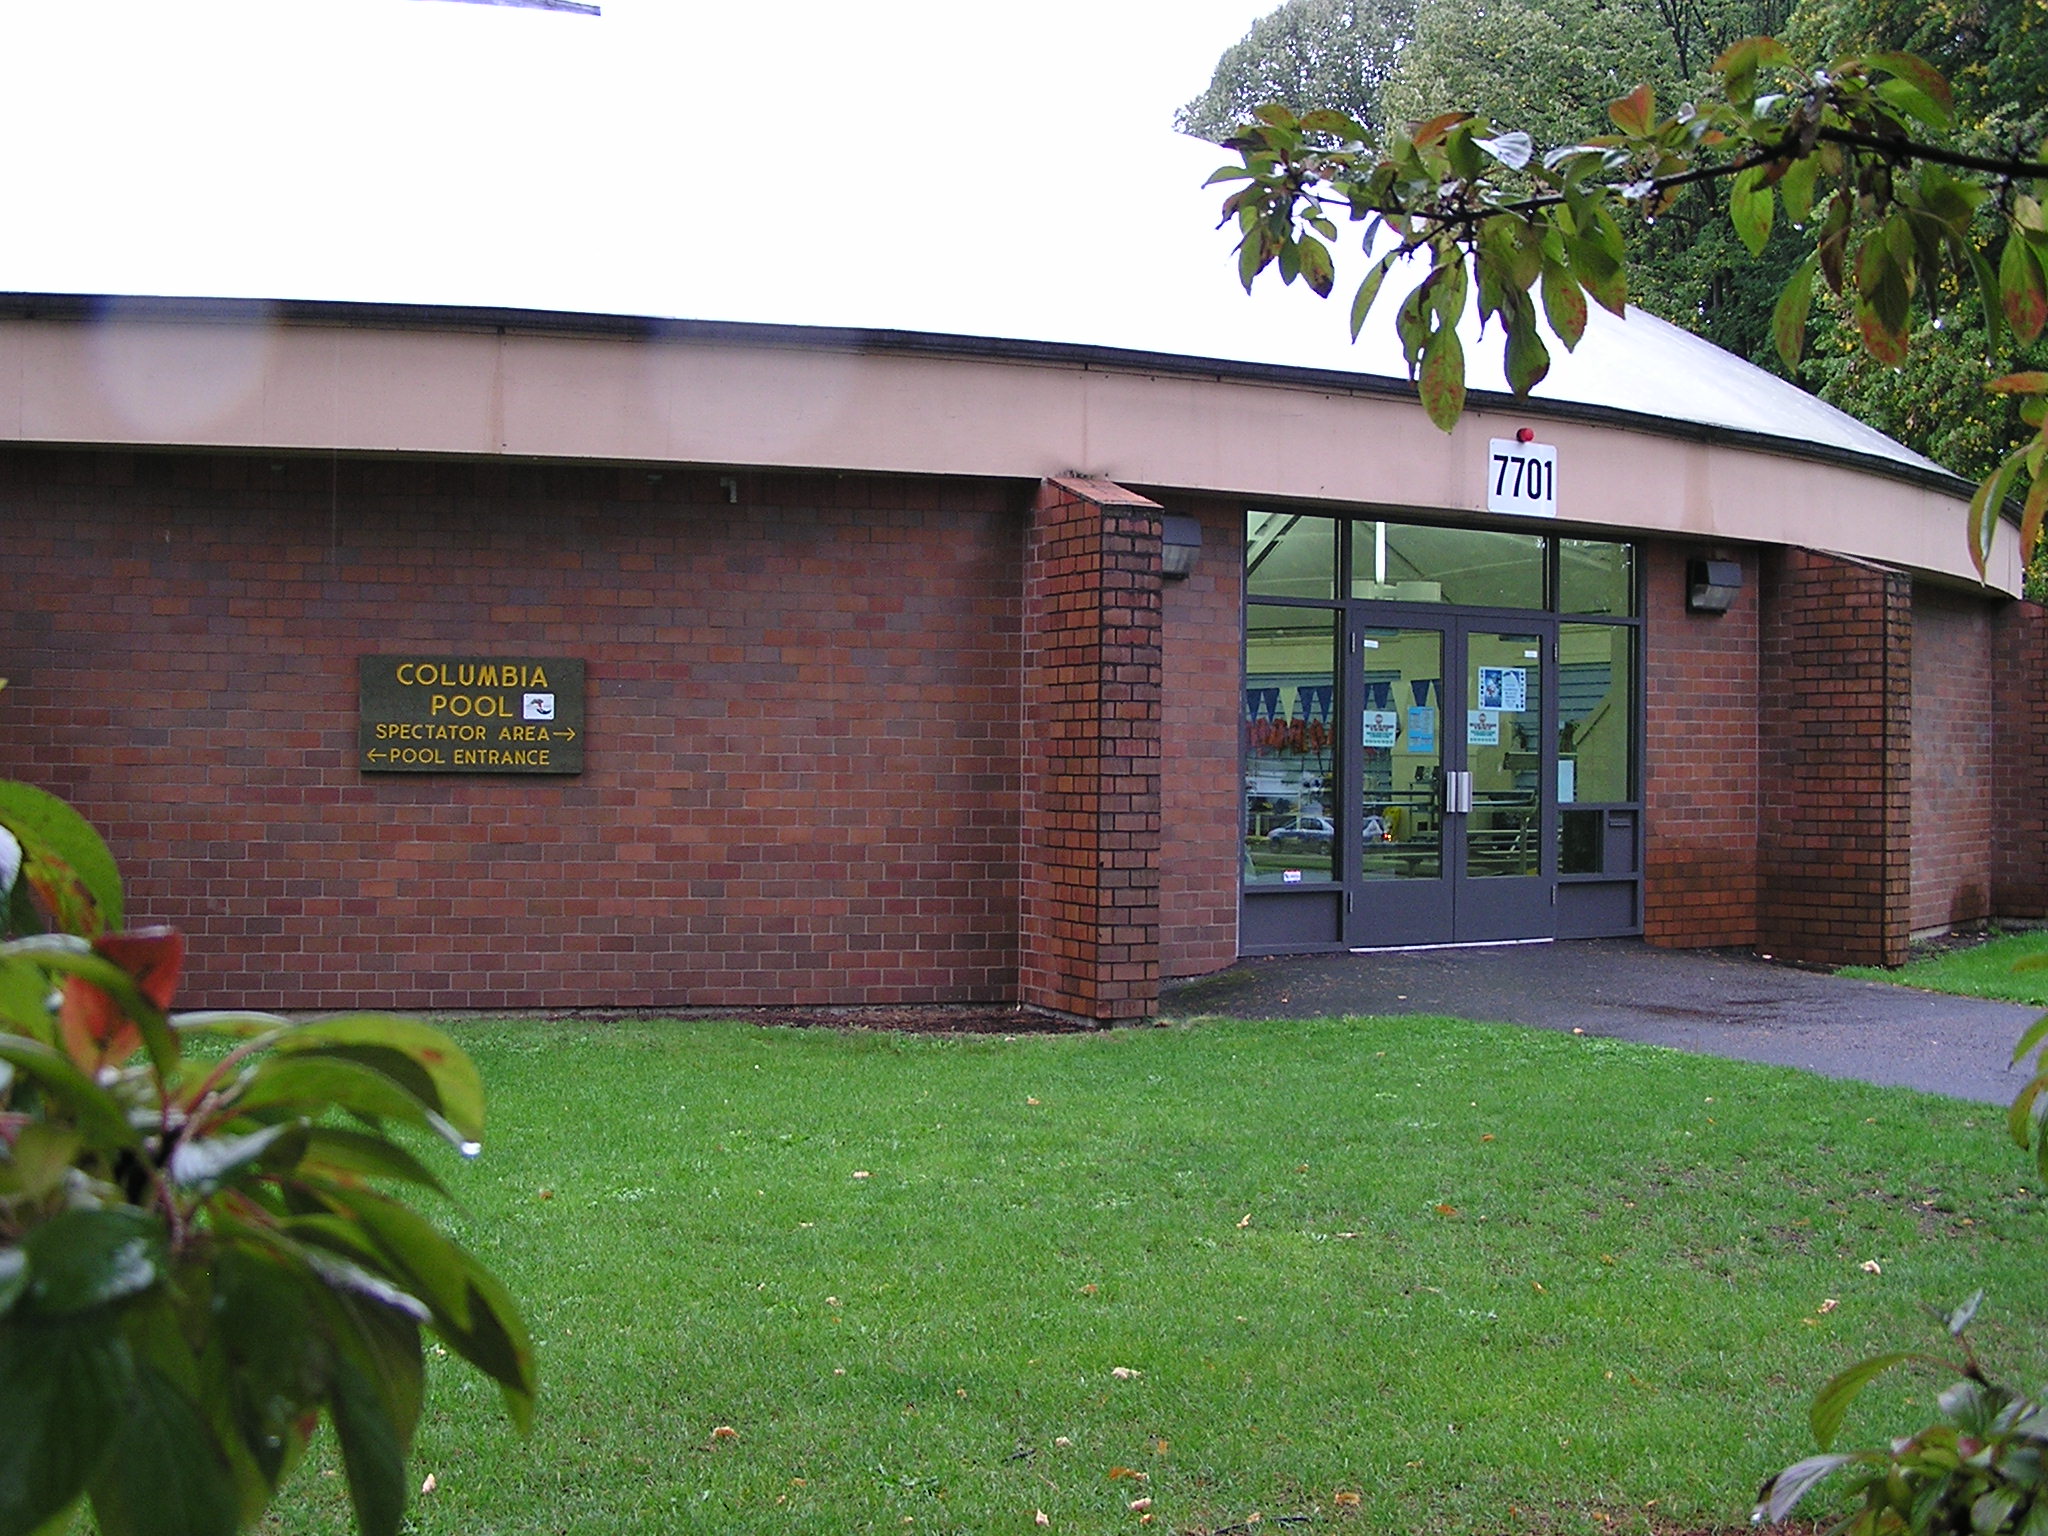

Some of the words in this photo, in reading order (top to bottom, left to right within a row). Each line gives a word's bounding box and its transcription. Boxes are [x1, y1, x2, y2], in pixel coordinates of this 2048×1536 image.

[1493, 454, 1552, 501] 7701
[396, 663, 549, 688] COLUMBIA
[431, 694, 513, 717] POOL
[376, 723, 486, 741] SPECTATOR
[498, 726, 550, 741] AREA
[390, 748, 445, 764] POOL
[454, 749, 550, 765] ENTRANCE
